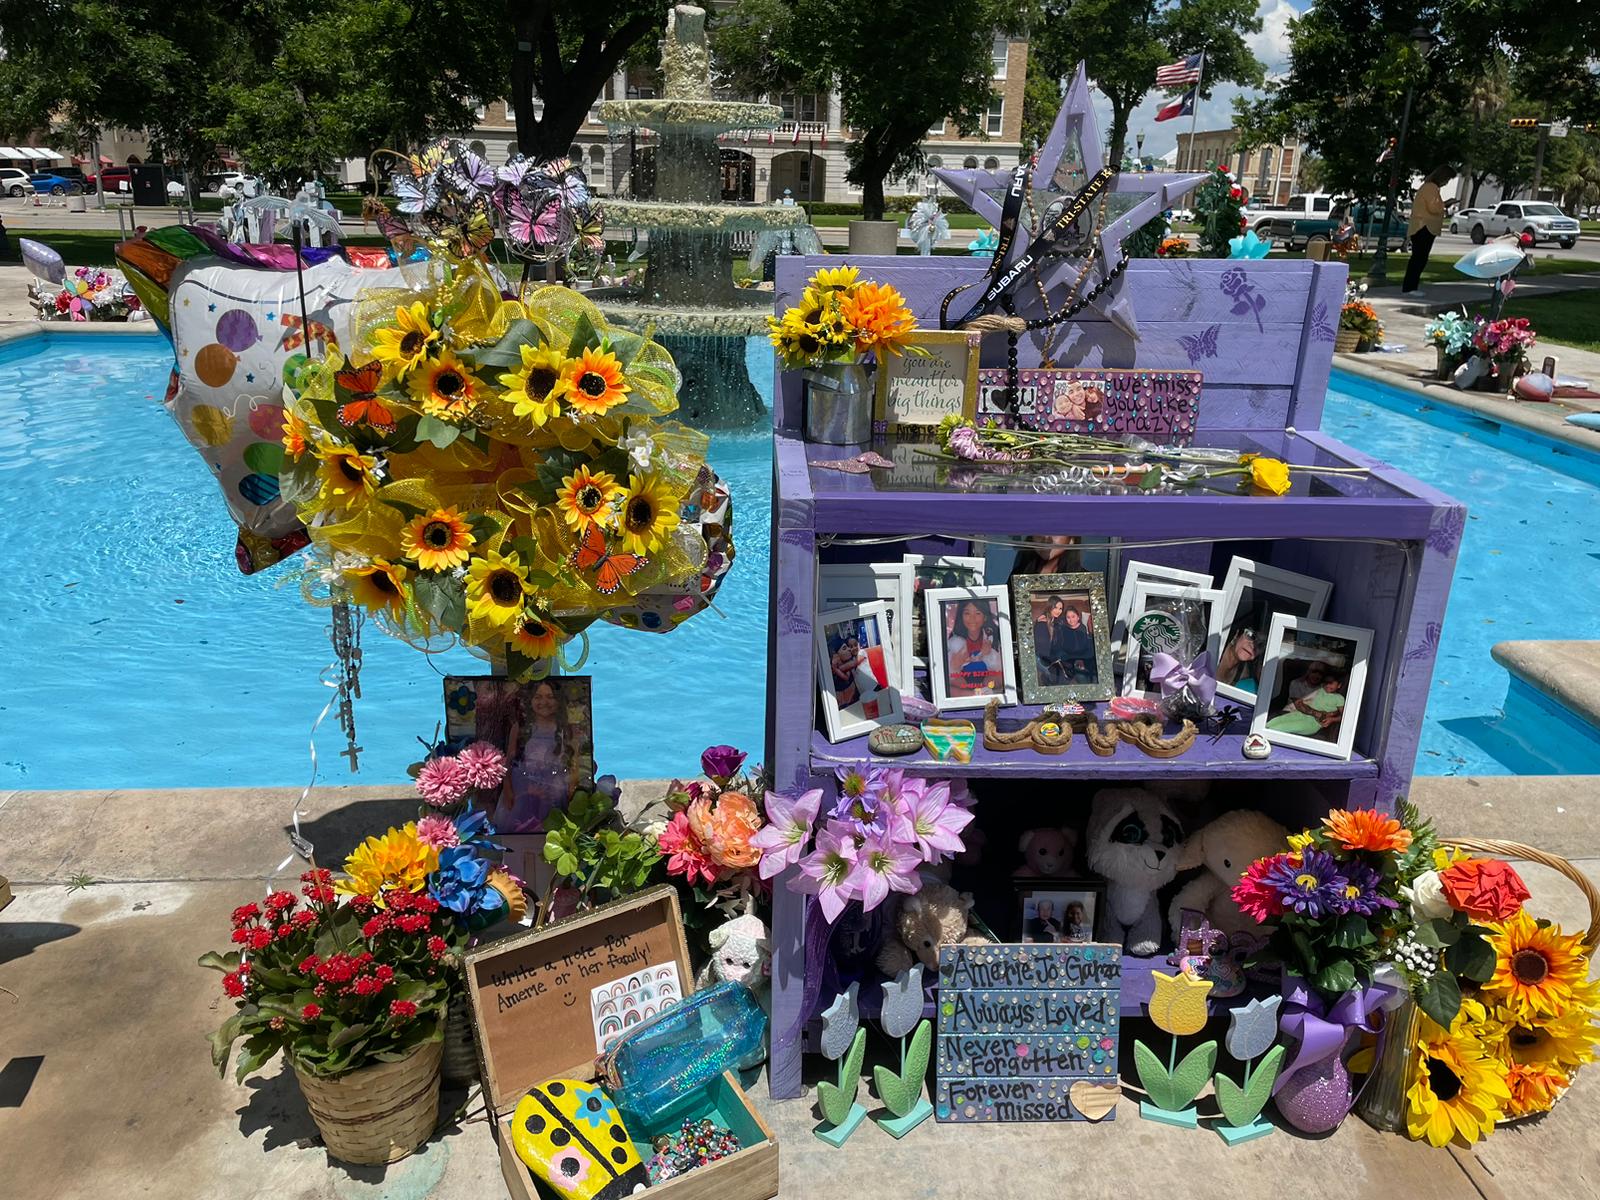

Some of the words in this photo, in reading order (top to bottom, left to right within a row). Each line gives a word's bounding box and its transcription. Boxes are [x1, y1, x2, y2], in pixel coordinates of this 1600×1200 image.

[1056, 178, 1104, 230] TRI-STATE
[987, 255, 1033, 301] SUBARU
[904, 358, 926, 375] you
[930, 357, 951, 368] are
[892, 370, 937, 387] meant
[938, 370, 959, 394] for
[1113, 378, 1141, 394] We
[1152, 379, 1200, 396] miss
[887, 387, 911, 417] big
[913, 390, 961, 415] things
[1106, 397, 1141, 417] you
[1114, 415, 1175, 435] crazy
[491, 964, 537, 988] Write
[545, 960, 557, 971] a
[562, 946, 596, 966] note
[605, 934, 631, 952] for
[951, 949, 1033, 987] Amerie
[1035, 956, 1058, 983] Jo
[497, 981, 547, 1013] Amerie
[555, 972, 571, 986] or
[577, 960, 603, 977] her
[606, 943, 653, 969] family!
[953, 991, 1035, 1031] Always
[1044, 997, 1106, 1025] Loved
[945, 1036, 1015, 1061] Never
[971, 1050, 1085, 1076] Forgotten
[948, 1081, 1035, 1110] Forever
[995, 1095, 1074, 1120] missed
